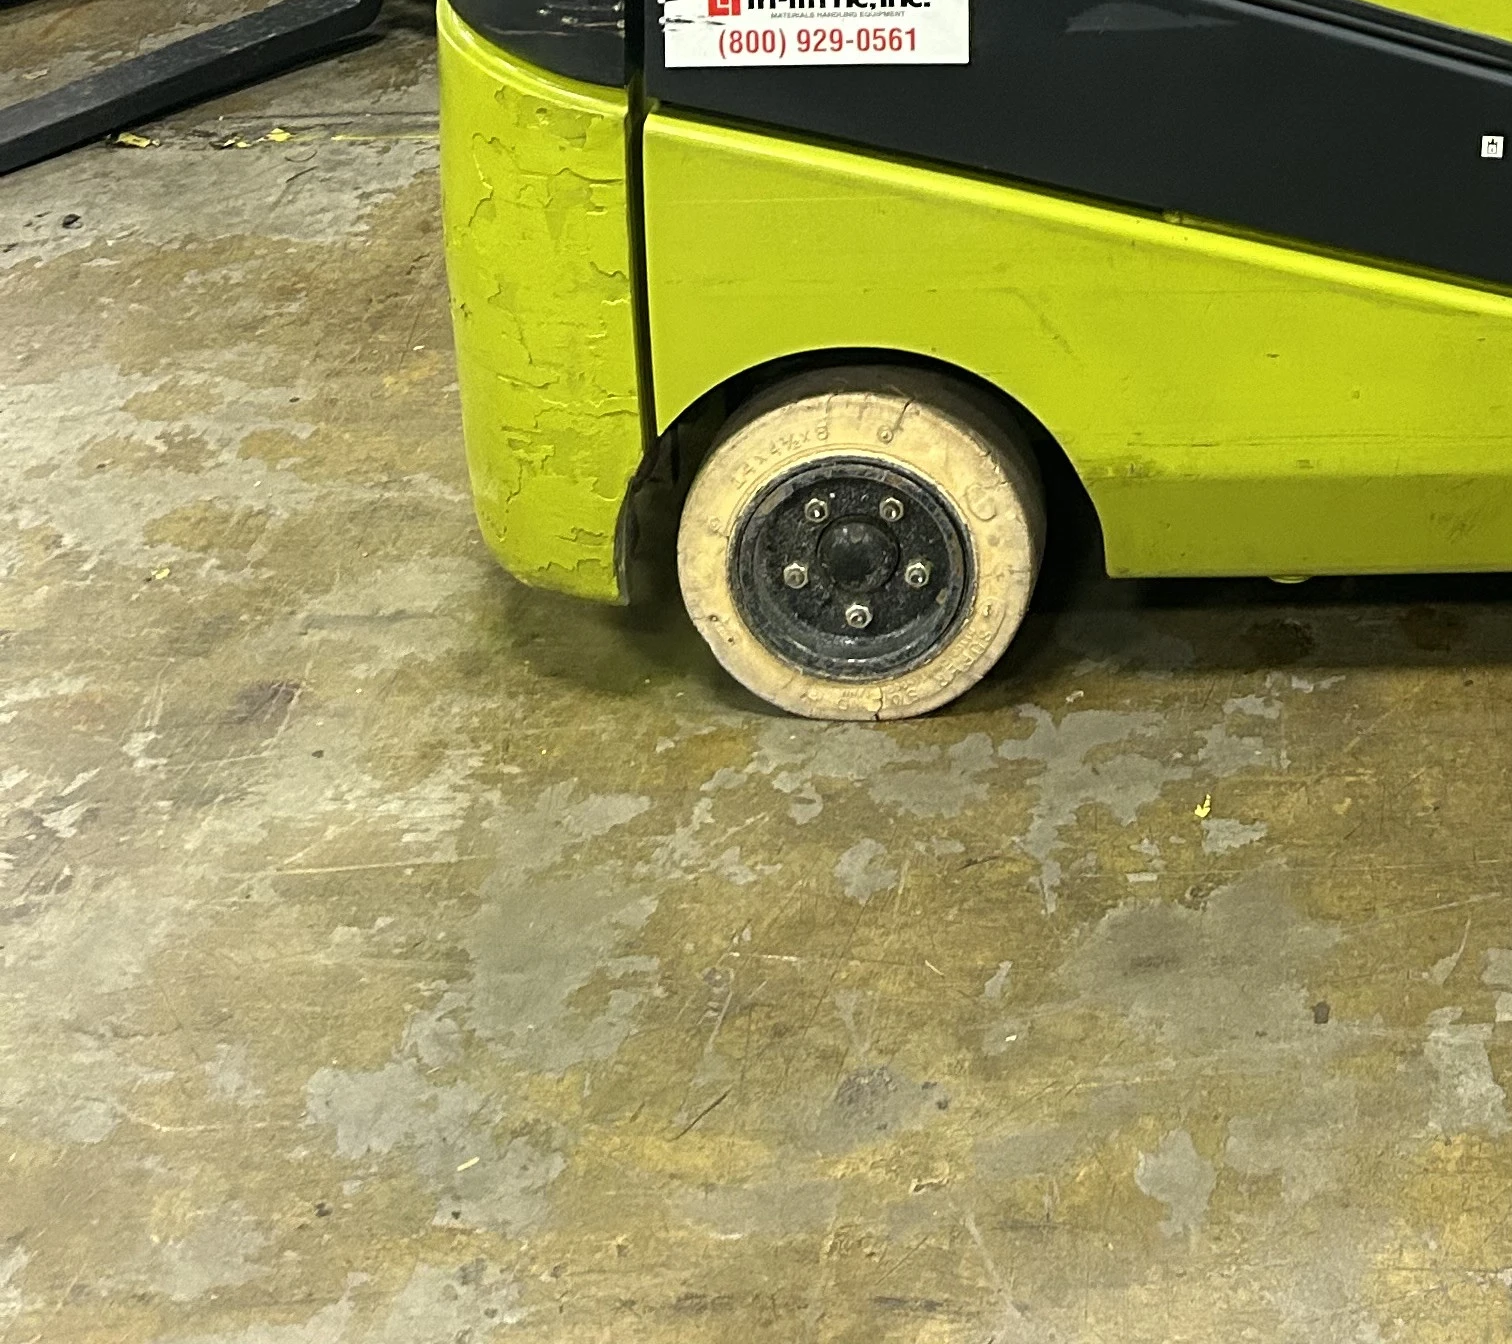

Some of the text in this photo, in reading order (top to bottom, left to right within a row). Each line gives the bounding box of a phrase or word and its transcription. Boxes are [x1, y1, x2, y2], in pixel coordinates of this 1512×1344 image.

[771, 10, 906, 19] MATERIALS HANDLING EQUIPMENT
[718, 27, 917, 60] (800) 929-0561
